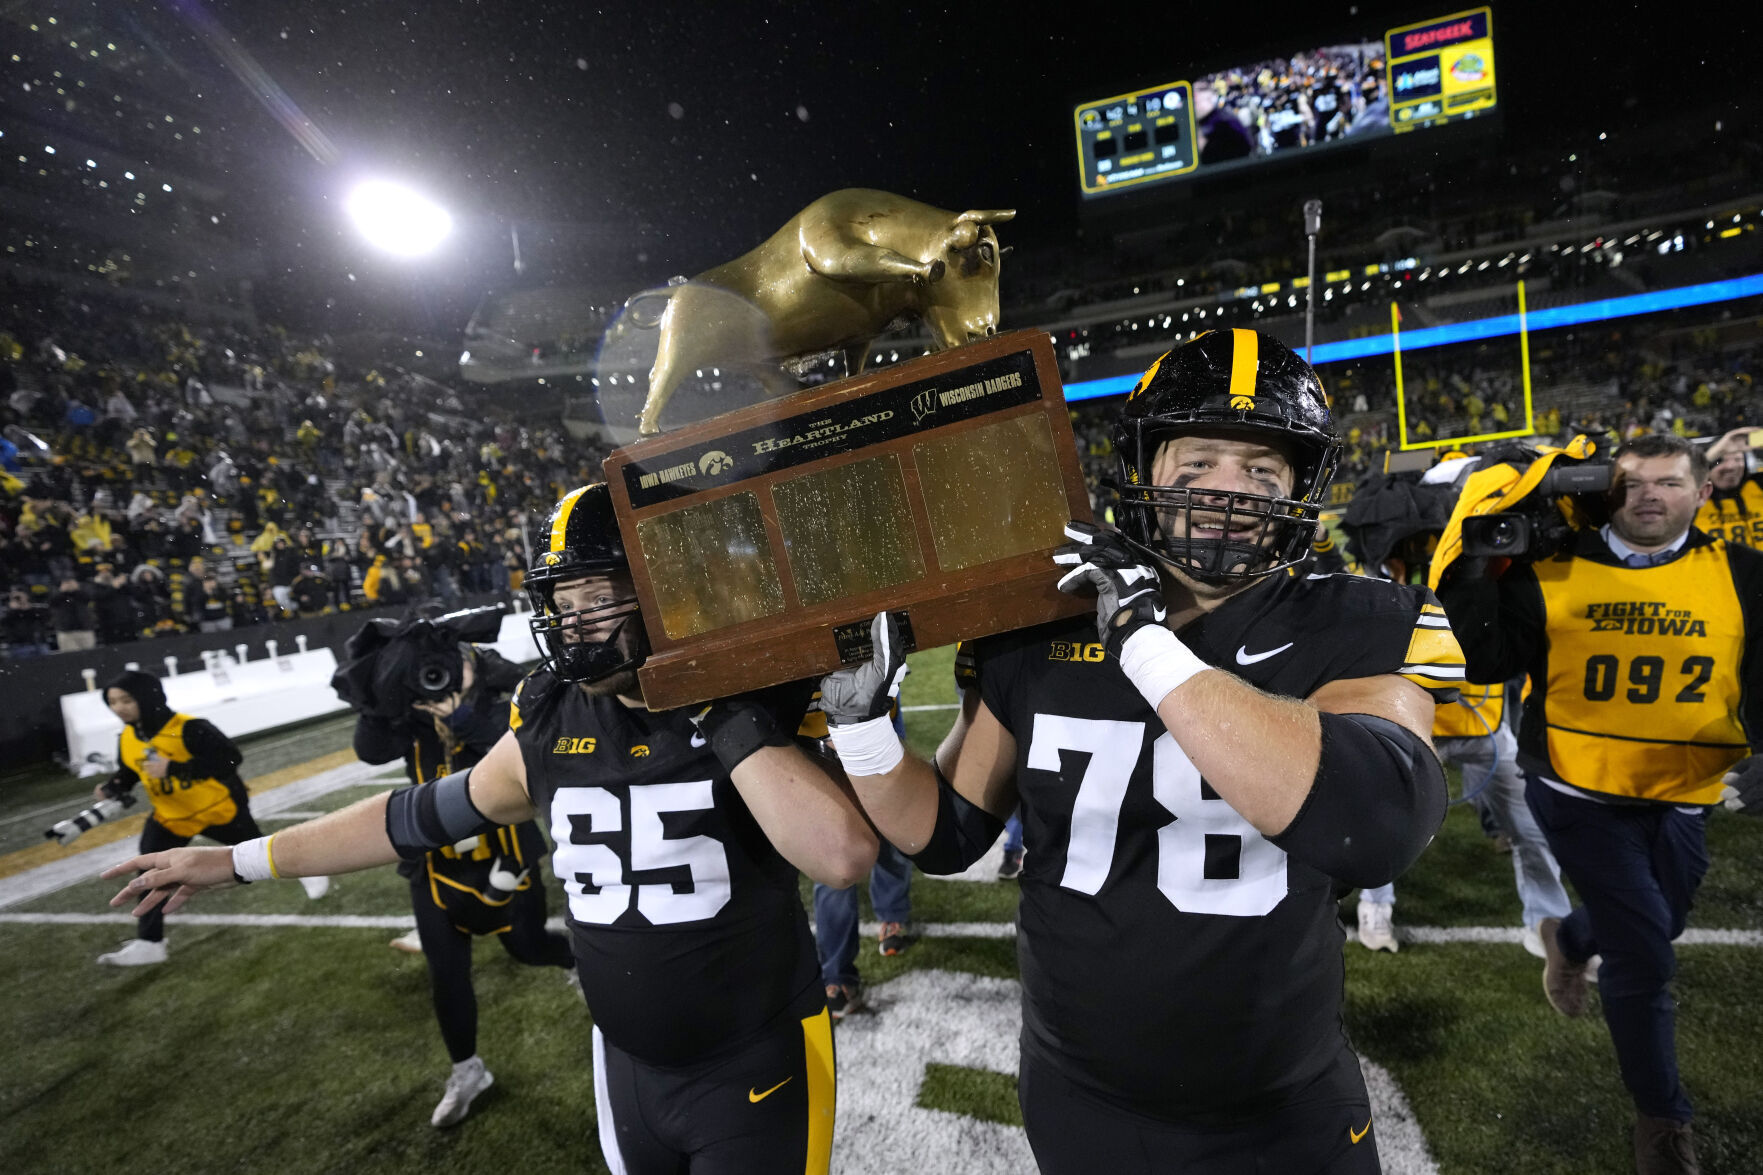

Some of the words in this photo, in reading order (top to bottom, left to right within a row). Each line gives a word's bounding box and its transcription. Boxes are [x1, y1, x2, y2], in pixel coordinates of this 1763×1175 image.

[1404, 20, 1473, 51] SEATGEEK
[939, 383, 985, 408] WISCONSIN
[985, 372, 1022, 396] BADGERS
[752, 410, 894, 456] HEARTLAND
[808, 417, 832, 428] THE
[802, 433, 848, 450] TROPHY
[639, 473, 660, 490] IOWA
[659, 461, 697, 485] HAWKEYES
[1585, 602, 1666, 619] FIGHT
[1665, 609, 1692, 619] FOR
[1624, 618, 1707, 638] IOWA
[1584, 654, 1715, 704] 092
[1027, 713, 1288, 917] 78
[551, 779, 731, 925] 65
